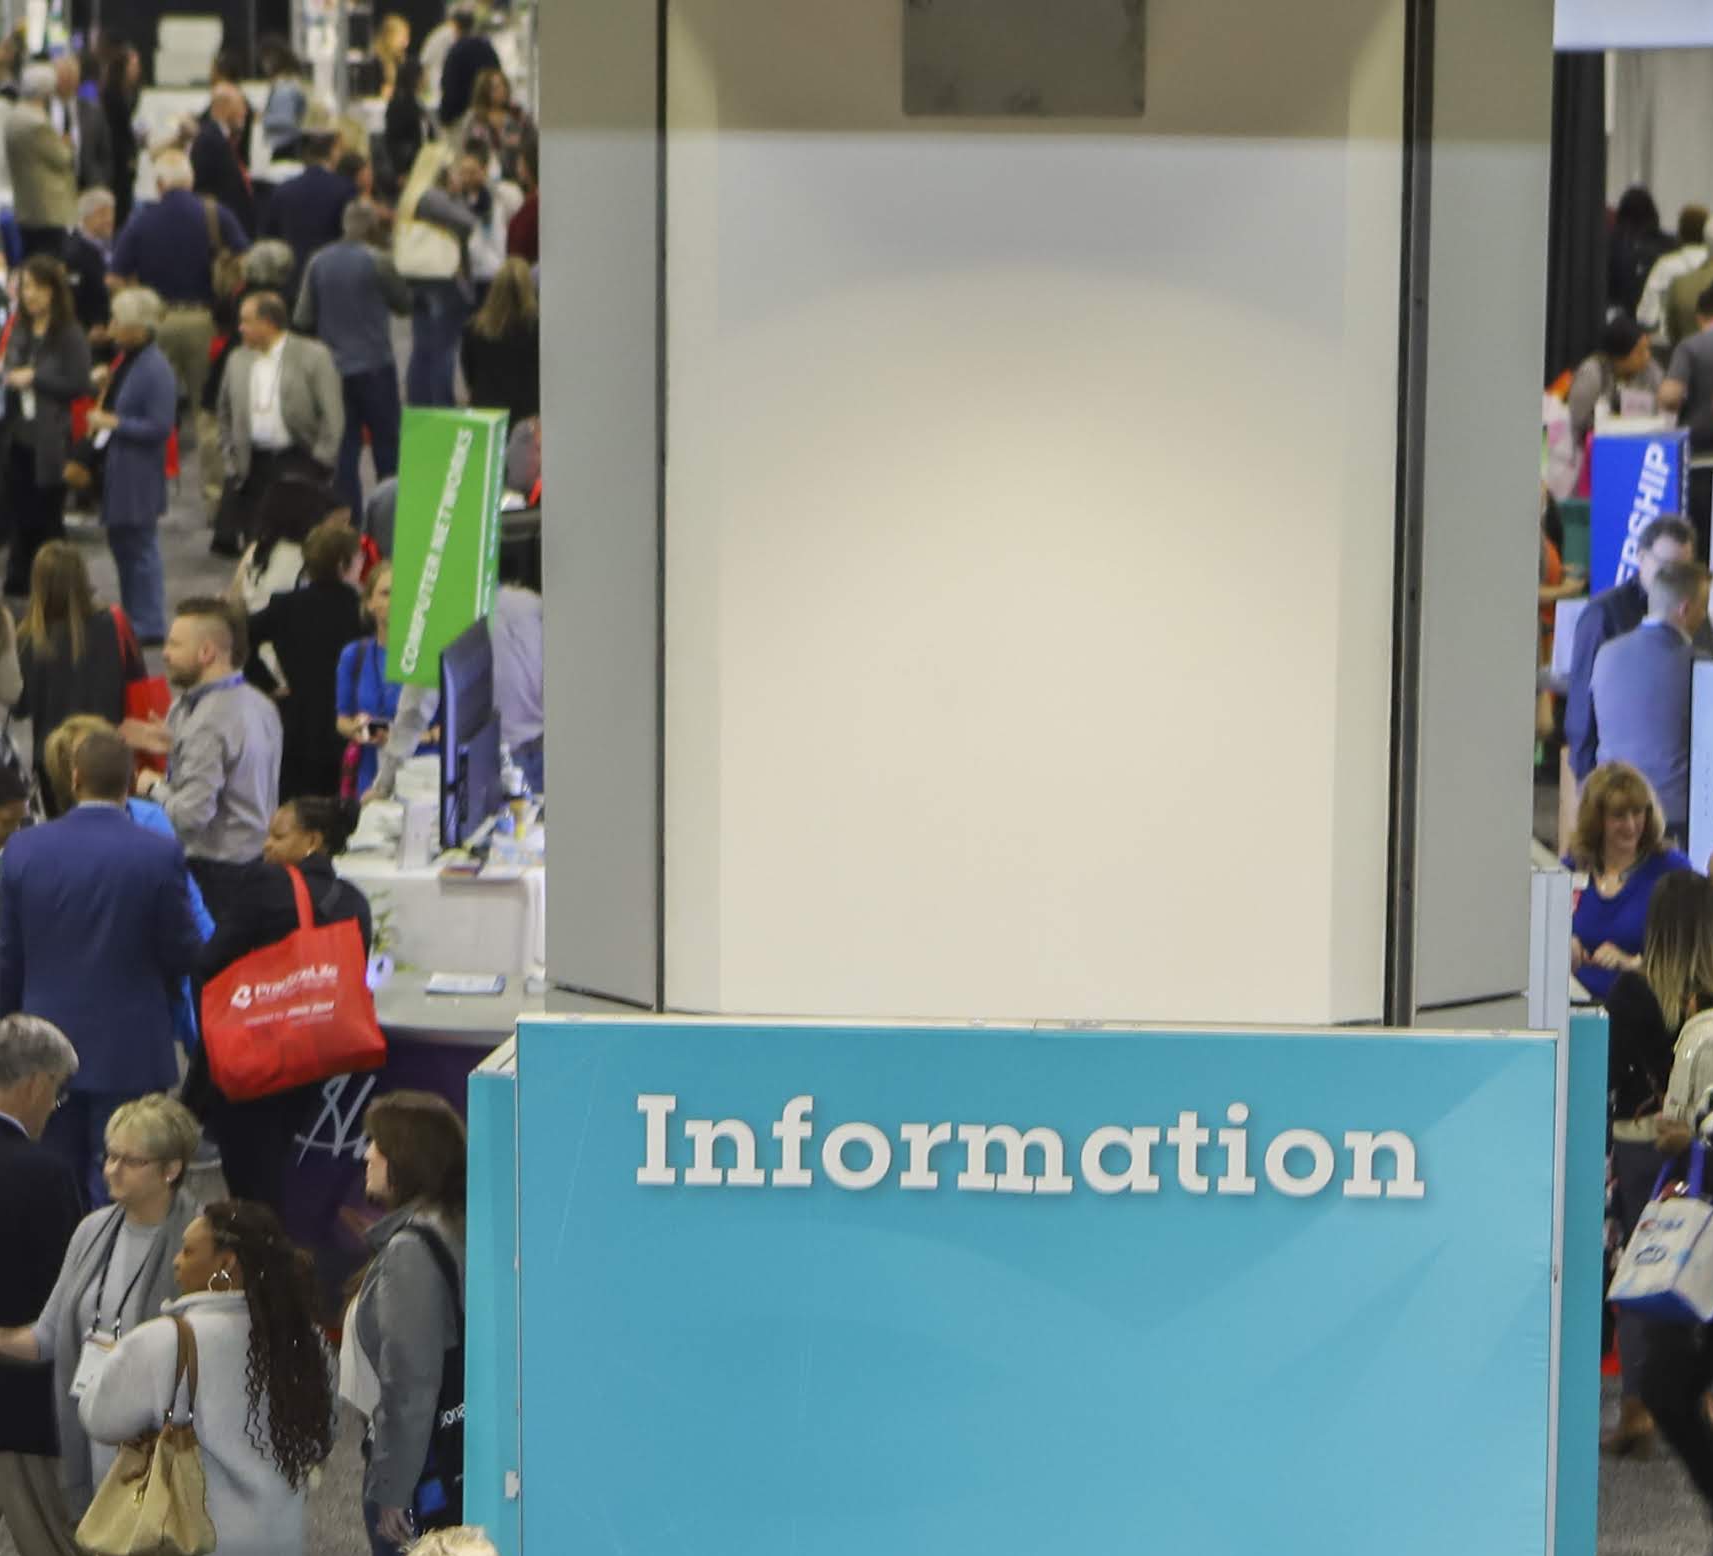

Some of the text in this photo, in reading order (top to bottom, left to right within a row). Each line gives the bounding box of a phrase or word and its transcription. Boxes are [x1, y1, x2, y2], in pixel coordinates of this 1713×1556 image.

[401, 427, 473, 674] COMPUTER NETWORKS
[636, 1094, 1425, 1200] Information
